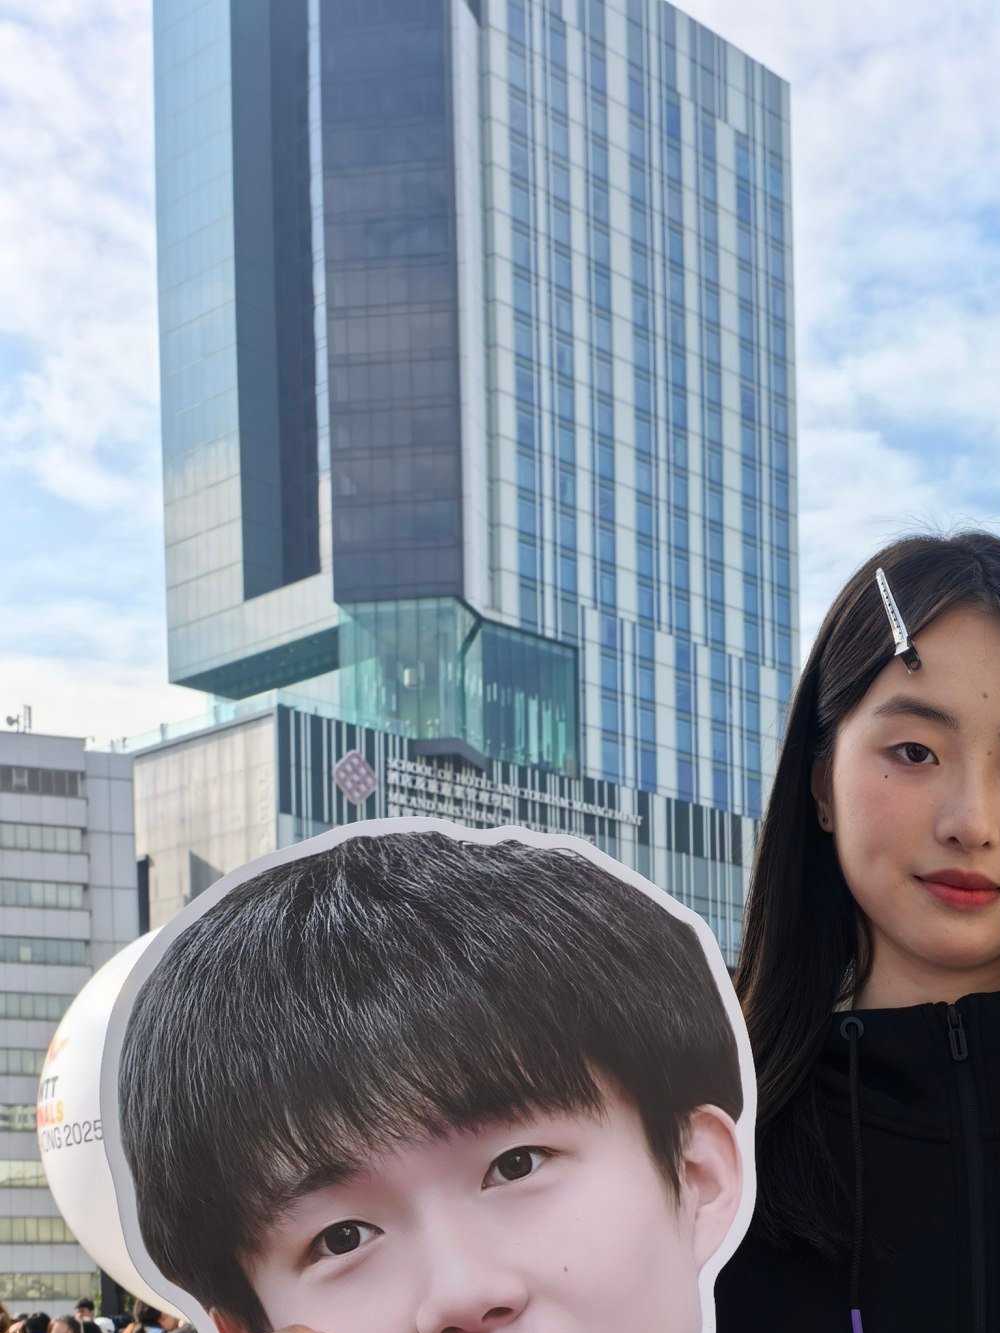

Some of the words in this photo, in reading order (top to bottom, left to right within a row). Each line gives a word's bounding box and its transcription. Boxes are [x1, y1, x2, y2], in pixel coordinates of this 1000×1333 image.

[387, 758, 434, 777] SCHOOL
[438, 769, 452, 781] OF
[455, 773, 493, 789] HOTEL
[496, 783, 520, 796] AND
[523, 788, 569, 808] TOURISM
[572, 801, 643, 827] MANAGEMENT
[409, 796, 434, 810] AND
[63, 1119, 103, 1147] 2025
